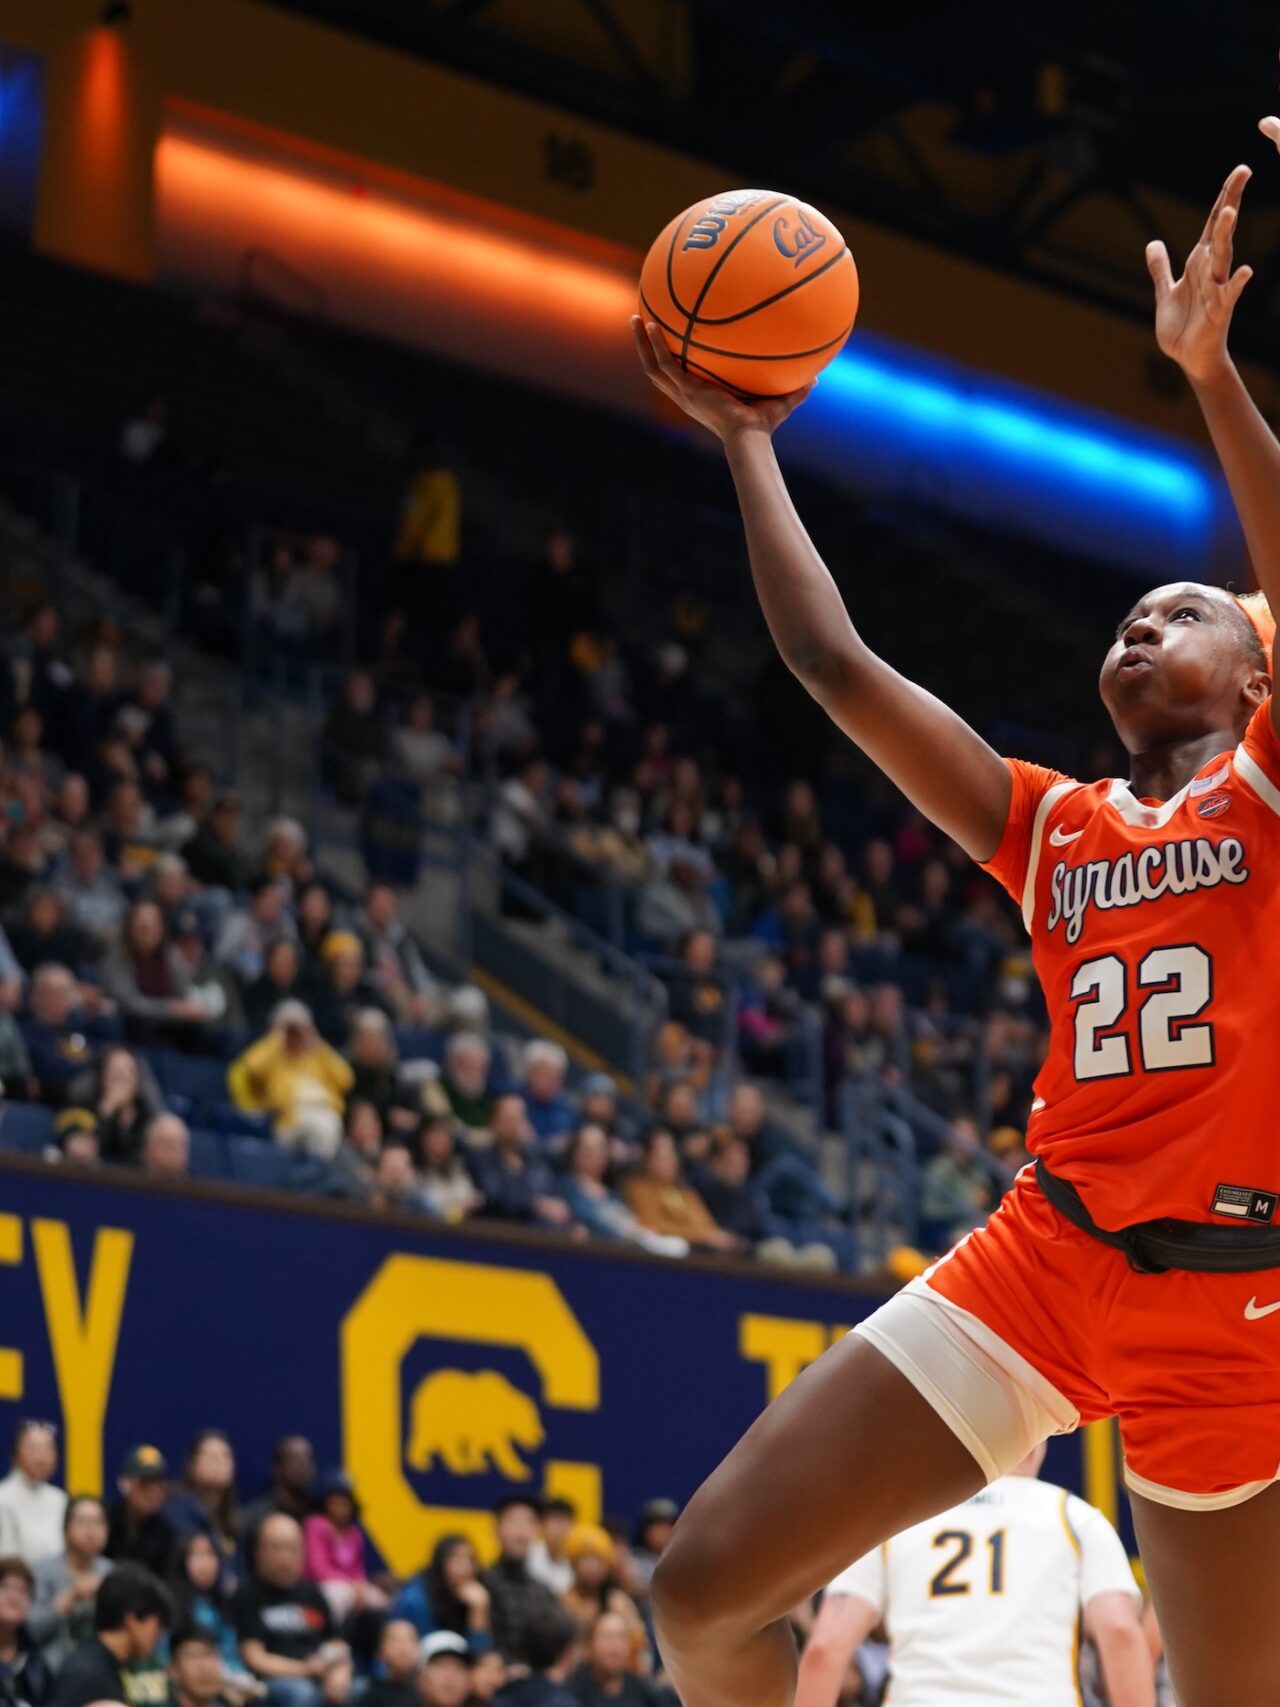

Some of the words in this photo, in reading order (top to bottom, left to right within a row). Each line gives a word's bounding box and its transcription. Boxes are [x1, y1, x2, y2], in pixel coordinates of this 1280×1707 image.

[773, 209, 826, 268] Cal
[1047, 837, 1248, 944] Syracuse
[1068, 942, 1216, 1083] 22
[1255, 1200, 1269, 1214] M
[930, 1526, 1008, 1599] 21
